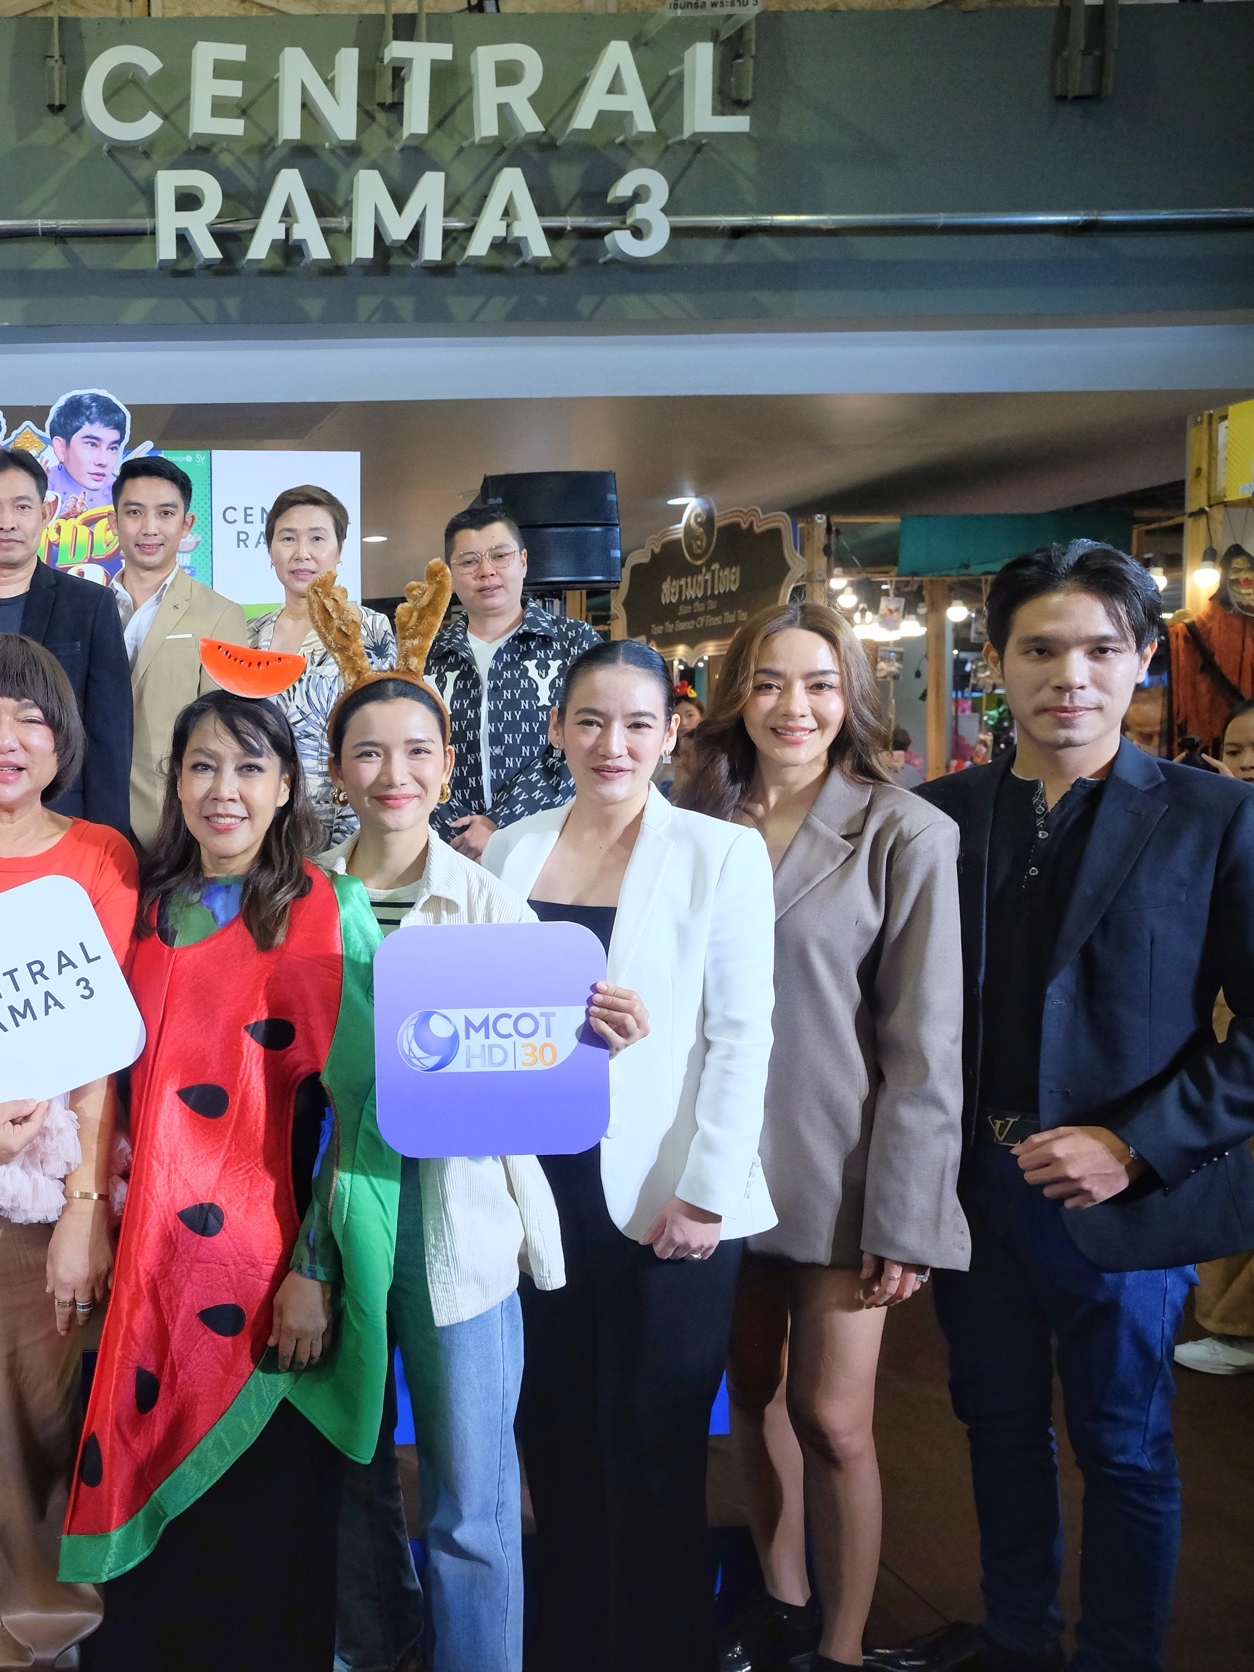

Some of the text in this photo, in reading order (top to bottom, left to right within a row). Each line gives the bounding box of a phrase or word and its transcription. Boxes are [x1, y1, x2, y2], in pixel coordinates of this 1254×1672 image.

[81, 40, 750, 146] CENTRAL
[153, 167, 670, 267] RAMA 3
[76, 977, 95, 1000] 3
[464, 1012, 556, 1040] MCOT
[466, 1042, 557, 1068] HD 30
